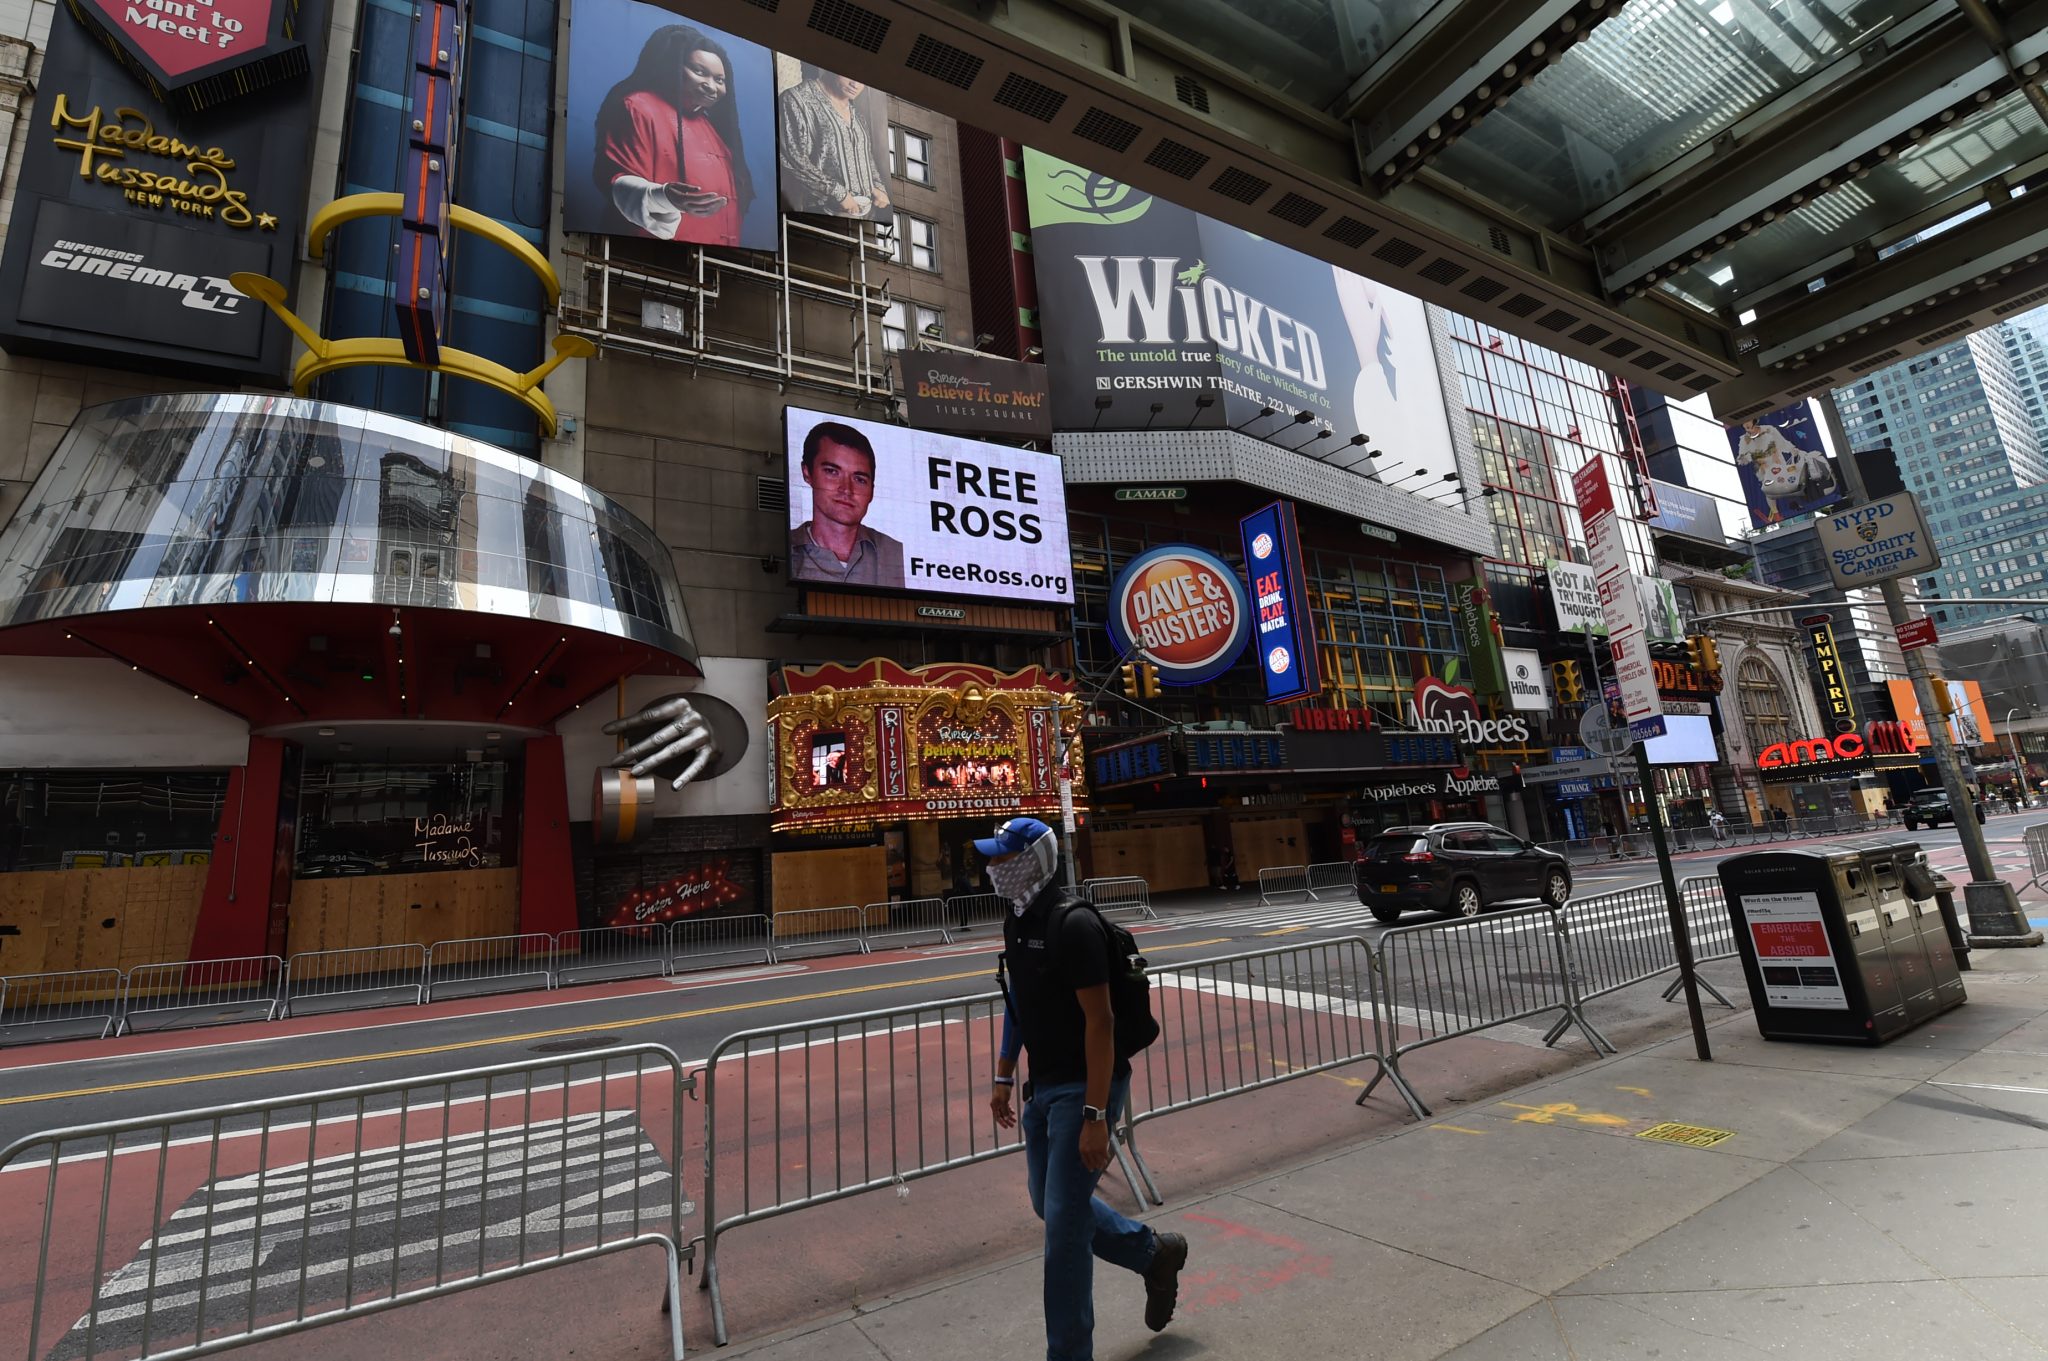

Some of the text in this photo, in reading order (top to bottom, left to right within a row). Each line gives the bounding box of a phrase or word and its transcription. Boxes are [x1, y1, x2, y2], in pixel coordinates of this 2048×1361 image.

[125, 6, 234, 48] Meet?
[127, 0, 243, 33] ant to
[51, 93, 236, 168] Madame
[53, 138, 253, 227] Tussauds
[124, 188, 215, 219] NEW YORK
[54, 239, 145, 263] EXPERIENCE
[1096, 349, 1331, 409] The untold true story of the Witches of Oz
[917, 382, 1041, 407] Believe It or Not!
[1113, 376, 1203, 389] GERSHWIN
[1207, 376, 1266, 408] THEATRE,
[1267, 396, 1285, 413] 222
[1325, 420, 1336, 433] St.
[935, 405, 1032, 420] TIMES SQUARE
[927, 456, 1038, 505] FREE
[1126, 489, 1177, 500] LAMAR
[930, 500, 1042, 544] ROSS
[1833, 503, 1894, 532] NYPD
[1832, 531, 1916, 564] SECURITY
[1841, 547, 1919, 575] CAMERA
[1865, 564, 1898, 577] IN AREA
[910, 557, 1067, 594] FreeRoss.org
[1256, 571, 1282, 597] EAT.
[1554, 570, 1578, 589] GOT
[1133, 572, 1224, 622] DAVE &
[1259, 591, 1283, 609] DRINK.
[1556, 588, 1575, 601] TRY
[1576, 591, 1594, 605] THE
[920, 607, 961, 618] LAMAR
[1140, 600, 1231, 649] BUSTER'S
[1260, 616, 1287, 634] WATCH.
[1261, 602, 1285, 622] PLAY.
[1904, 621, 1928, 631] STANDING
[1617, 660, 1642, 674] COMMERCIAL
[1620, 667, 1648, 684] VEHICLES ONLY
[1813, 631, 1847, 714] EMPIRE
[1511, 681, 1541, 695] Hilton
[1292, 706, 1373, 732] LIBERTY
[939, 726, 981, 743] Ripley's
[883, 710, 900, 794] Ripley's
[923, 743, 1016, 756] Believe It or Not!
[1032, 712, 1048, 789] Ripley's
[1758, 733, 1865, 768] amc
[1097, 743, 1162, 785] DINER
[1362, 782, 1436, 801] Applebee's
[1444, 773, 1500, 796] Applebee's
[1561, 783, 1590, 793] EXCHANGE
[926, 798, 1021, 810] ODDITORIUM
[415, 813, 474, 839] Madame
[329, 854, 347, 863] 234
[415, 836, 480, 868] Tussauds
[634, 880, 711, 921] Enter Here
[1760, 922, 1814, 934] EMBRACE
[1770, 945, 1815, 956] ABSURD
